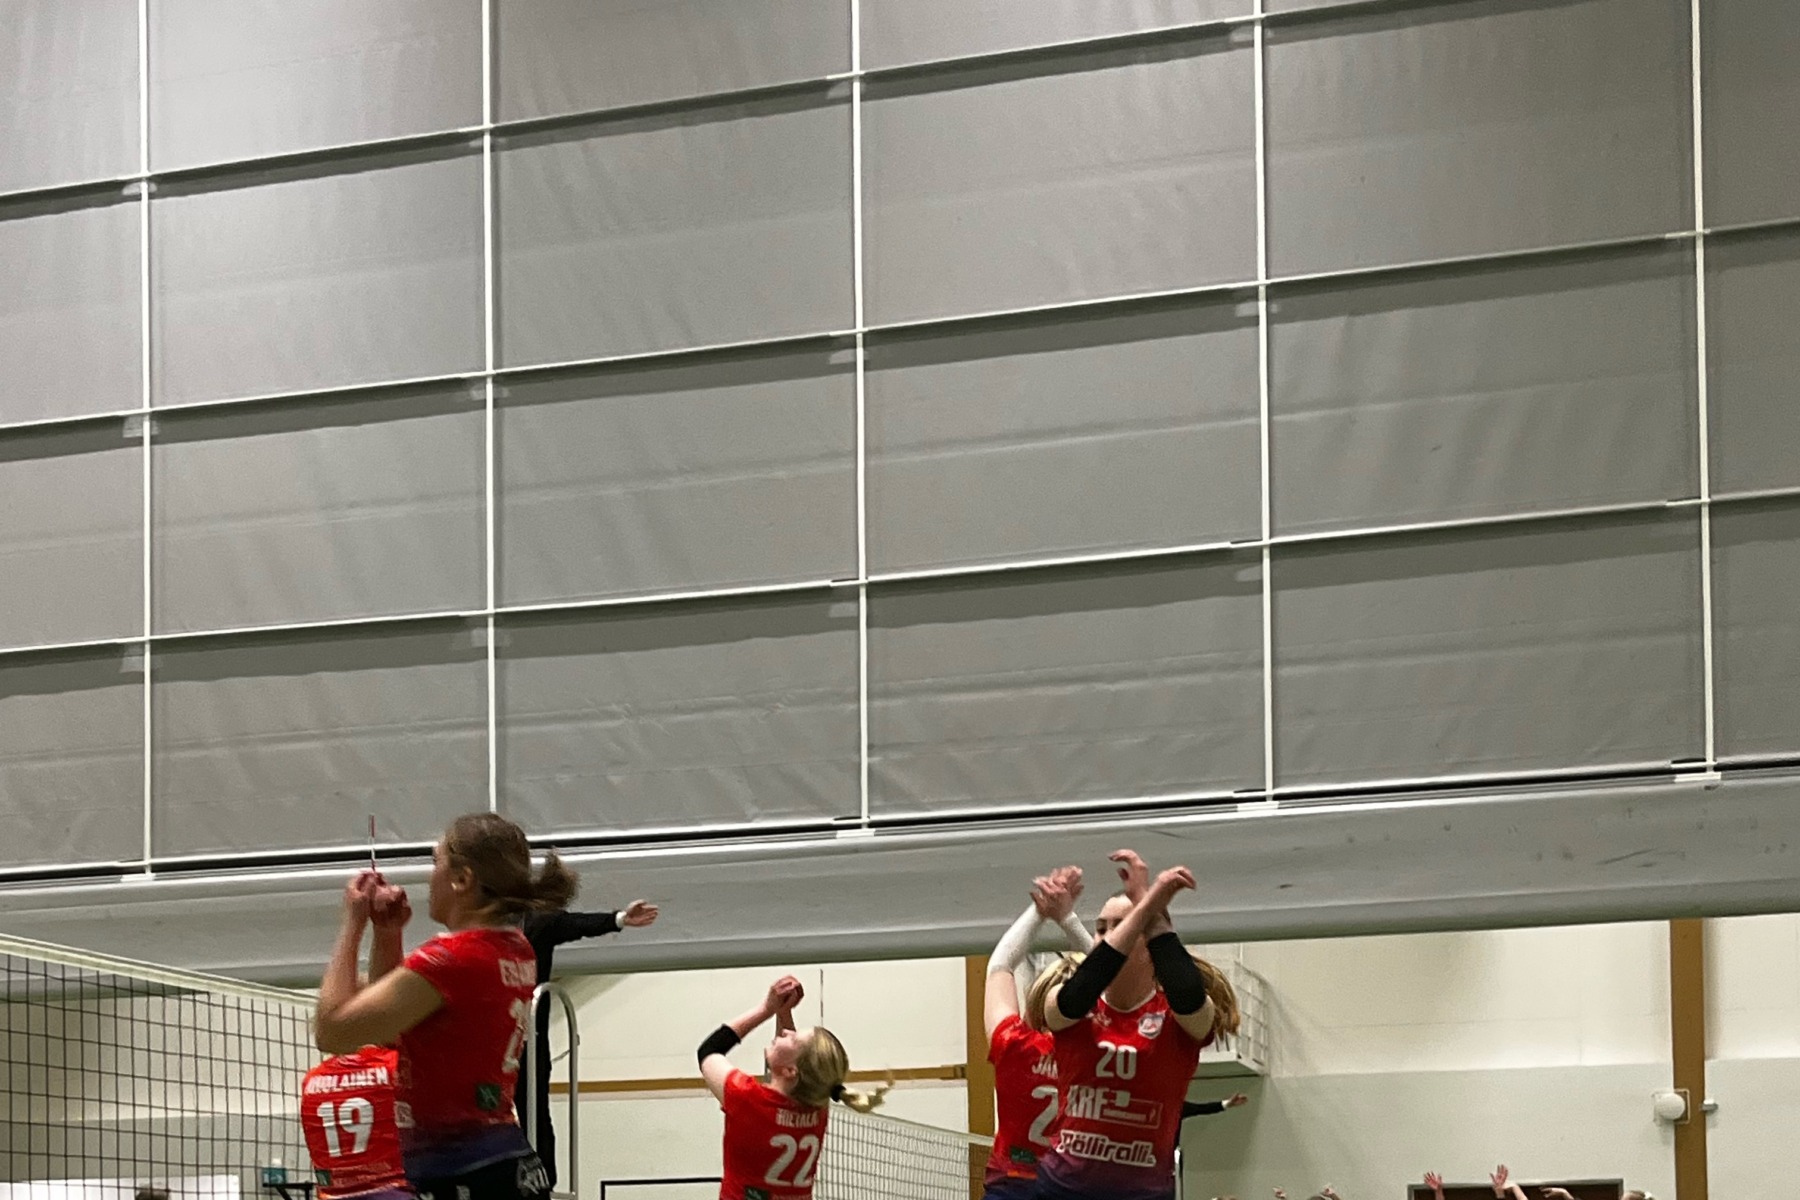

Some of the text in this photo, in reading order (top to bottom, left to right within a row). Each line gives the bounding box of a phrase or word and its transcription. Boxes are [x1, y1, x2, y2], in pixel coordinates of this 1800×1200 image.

[1096, 1041, 1137, 1080] 20
[317, 1097, 374, 1157] 19
[764, 1133, 820, 1188] 22
